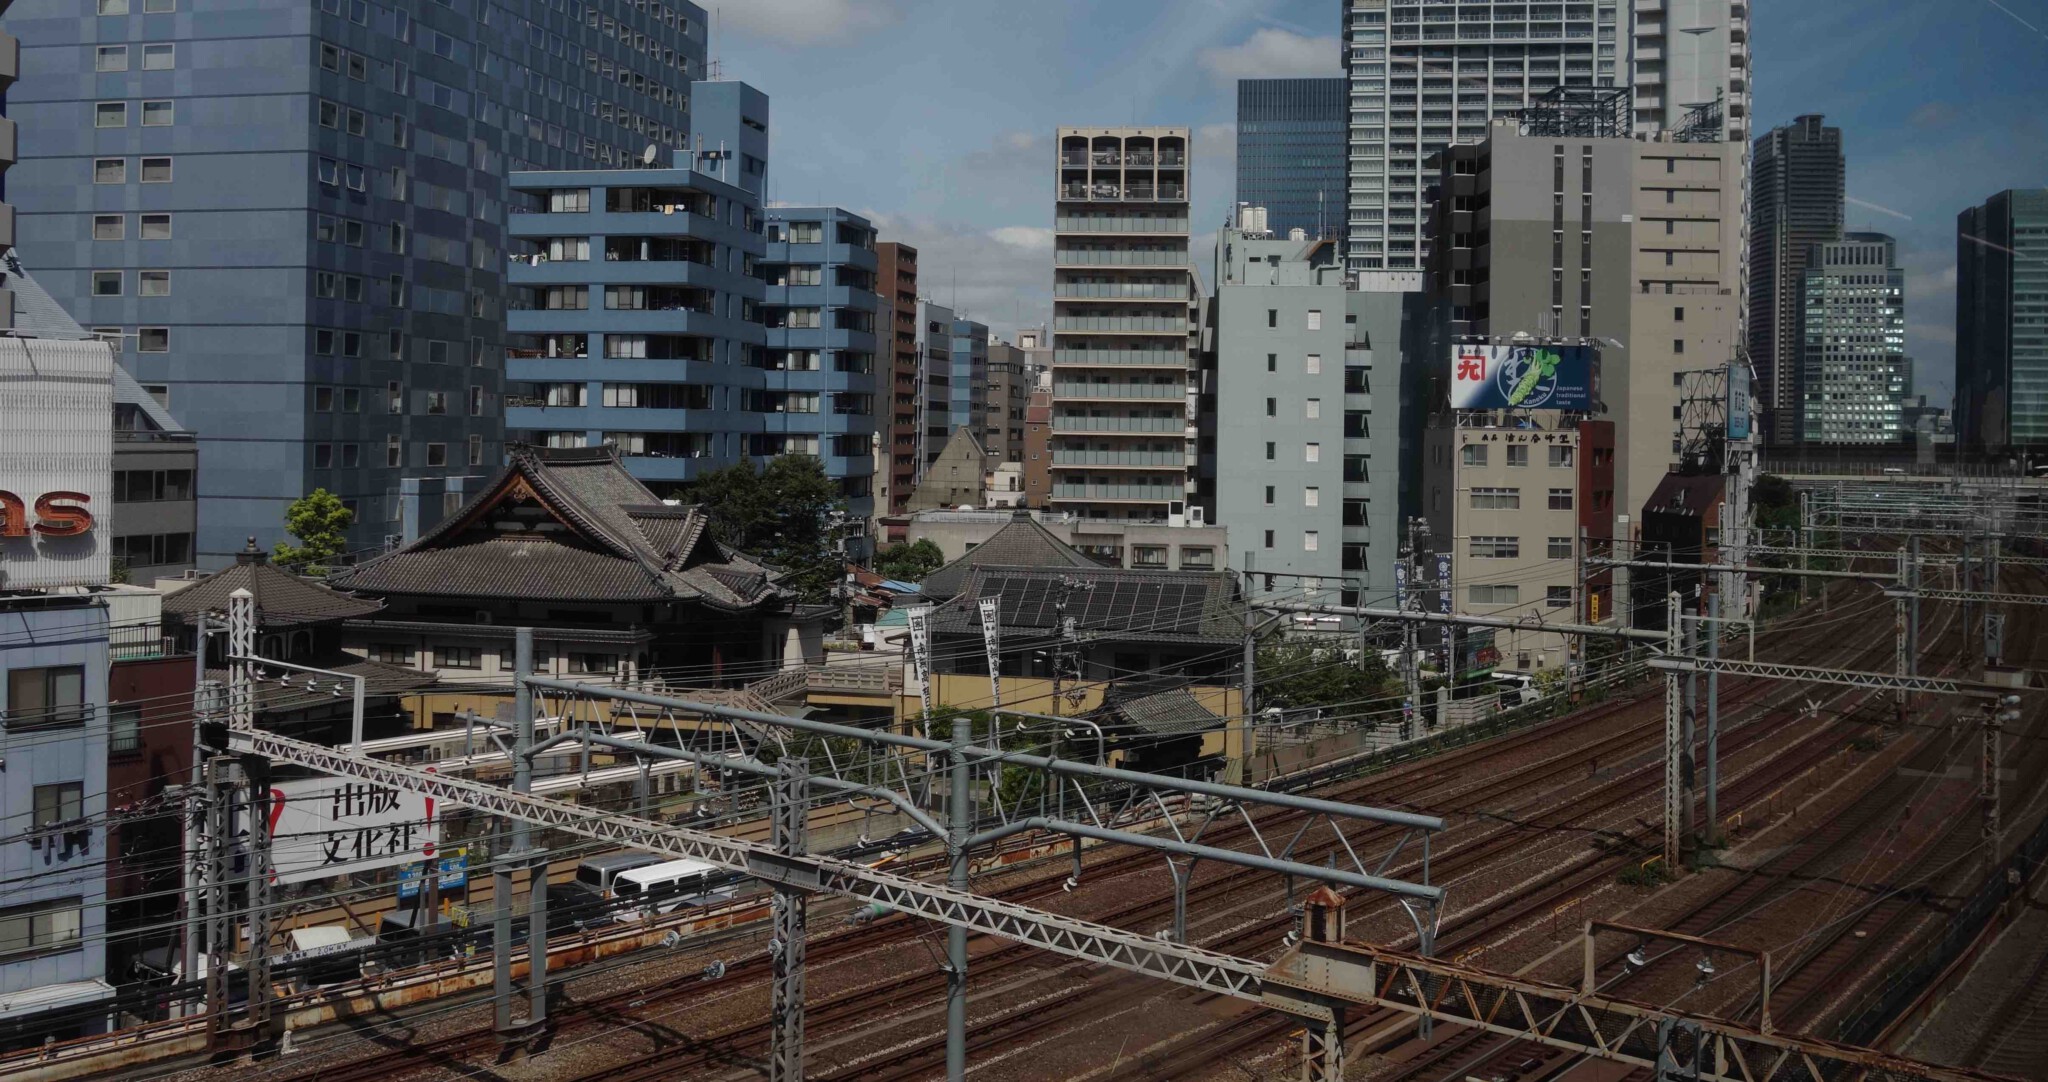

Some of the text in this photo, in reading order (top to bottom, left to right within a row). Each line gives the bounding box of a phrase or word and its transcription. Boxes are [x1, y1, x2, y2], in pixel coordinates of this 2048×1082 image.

[1523, 393, 1547, 405] Kaneku
[333, 783, 401, 821] 出版
[322, 821, 418, 866] 文化社
